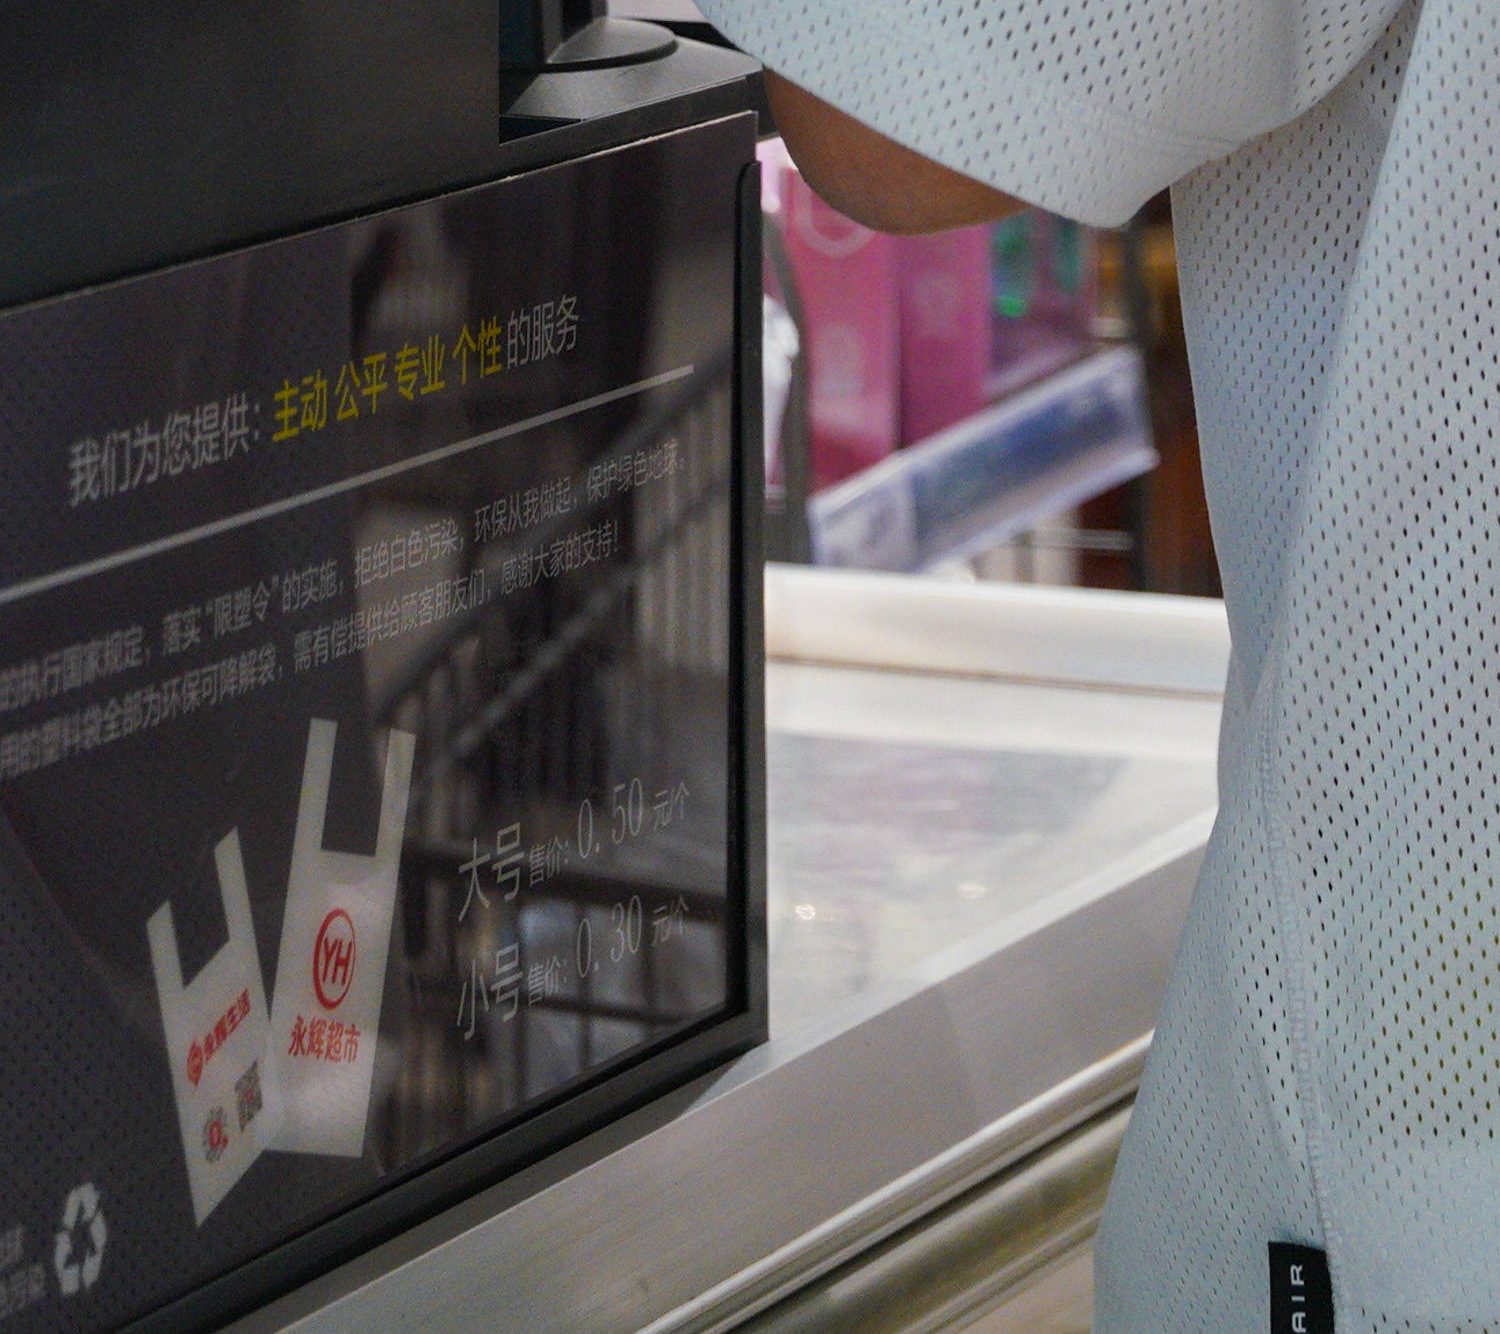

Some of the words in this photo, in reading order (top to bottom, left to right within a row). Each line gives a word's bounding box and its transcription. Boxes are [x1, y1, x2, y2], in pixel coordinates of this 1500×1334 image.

[68, 390, 262, 508] 我们为您提供:
[271, 369, 329, 443] 主动
[334, 351, 388, 423] 公平
[392, 334, 447, 402] 专业
[287, 1015, 361, 1064] 永辉超市
